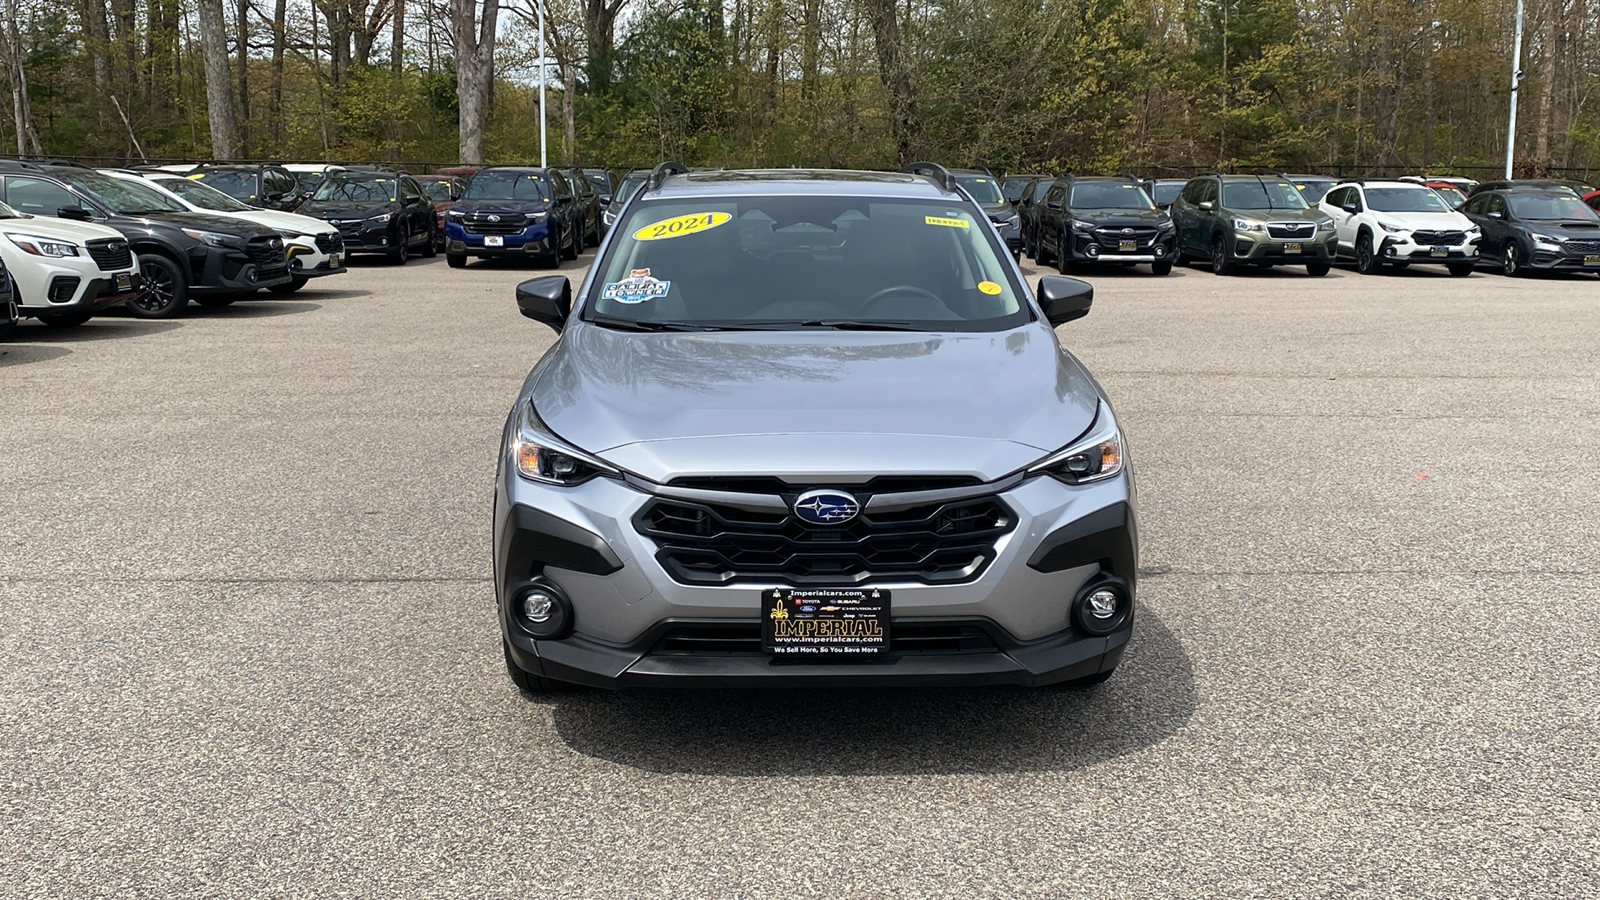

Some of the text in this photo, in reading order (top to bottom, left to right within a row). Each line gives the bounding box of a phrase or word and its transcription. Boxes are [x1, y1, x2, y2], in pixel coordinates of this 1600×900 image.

[653, 214, 714, 237] 2024
[616, 289, 665, 297] OWNER
[775, 620, 882, 636] IMPERIAL
